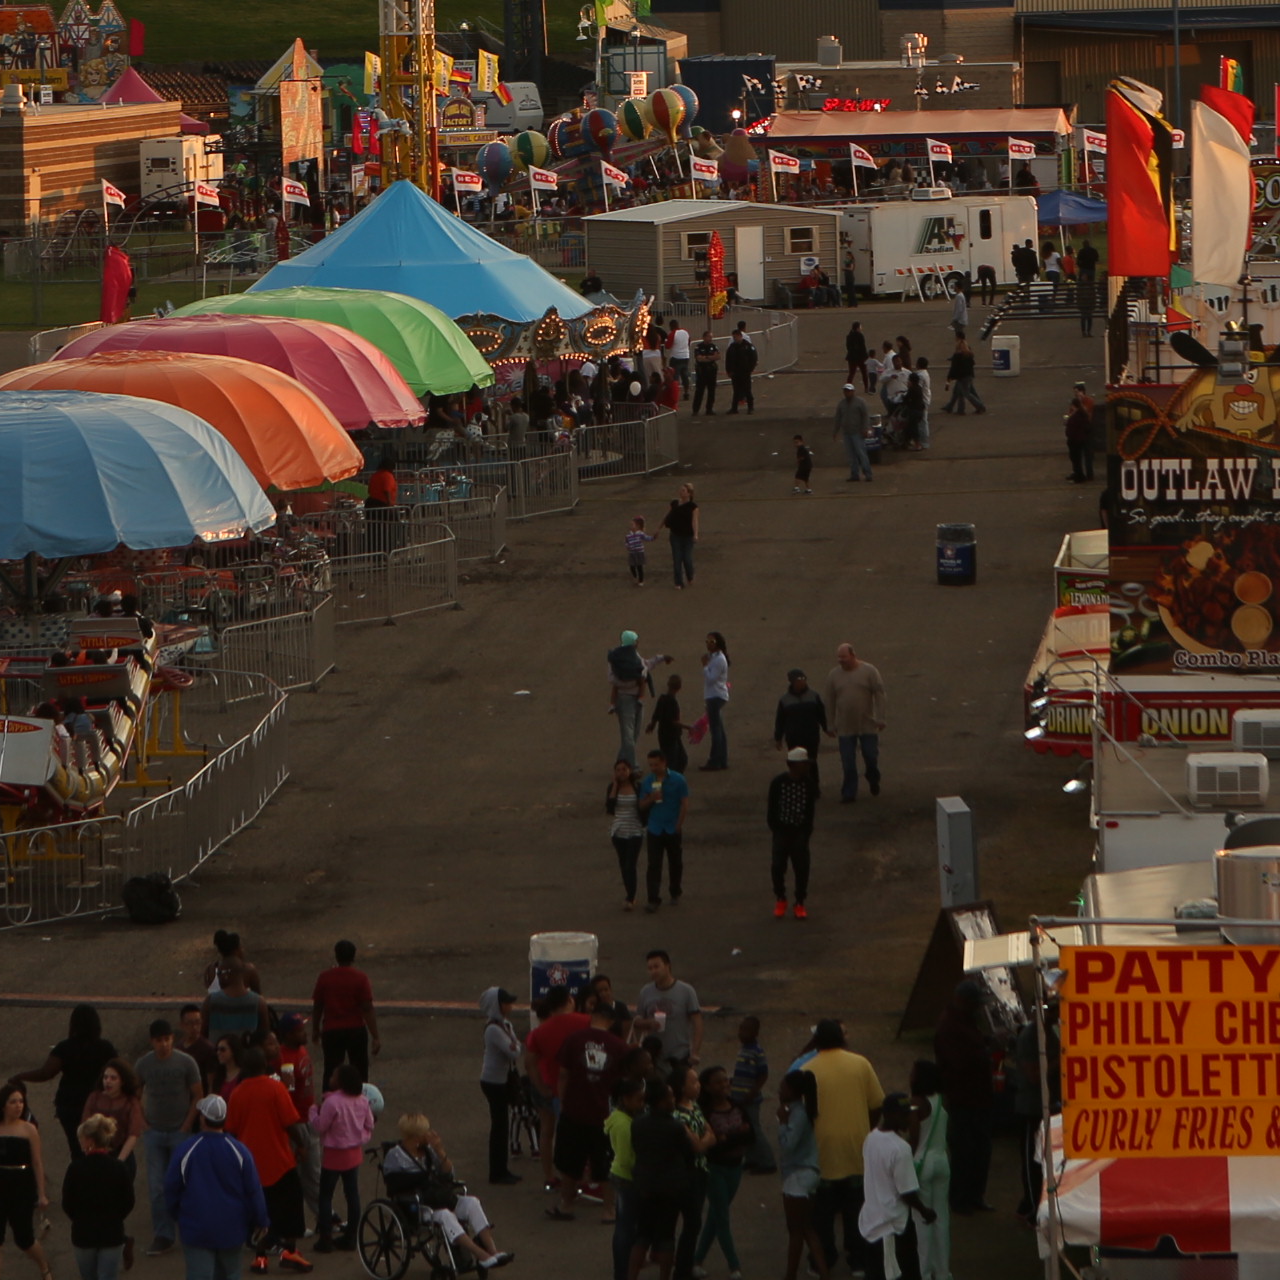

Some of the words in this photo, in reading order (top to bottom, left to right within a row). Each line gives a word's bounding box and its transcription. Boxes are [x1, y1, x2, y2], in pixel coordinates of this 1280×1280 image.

[1121, 457, 1258, 500] OUTLAW
[1174, 649, 1242, 668] Combo
[1047, 706, 1105, 735] DRINK
[1141, 708, 1228, 735] ONION
[1073, 949, 1280, 995] PATTY
[1067, 1000, 1191, 1046] PHILLY
[1071, 1107, 1161, 1152] CURLY
[1172, 1105, 1254, 1151] FRIES
